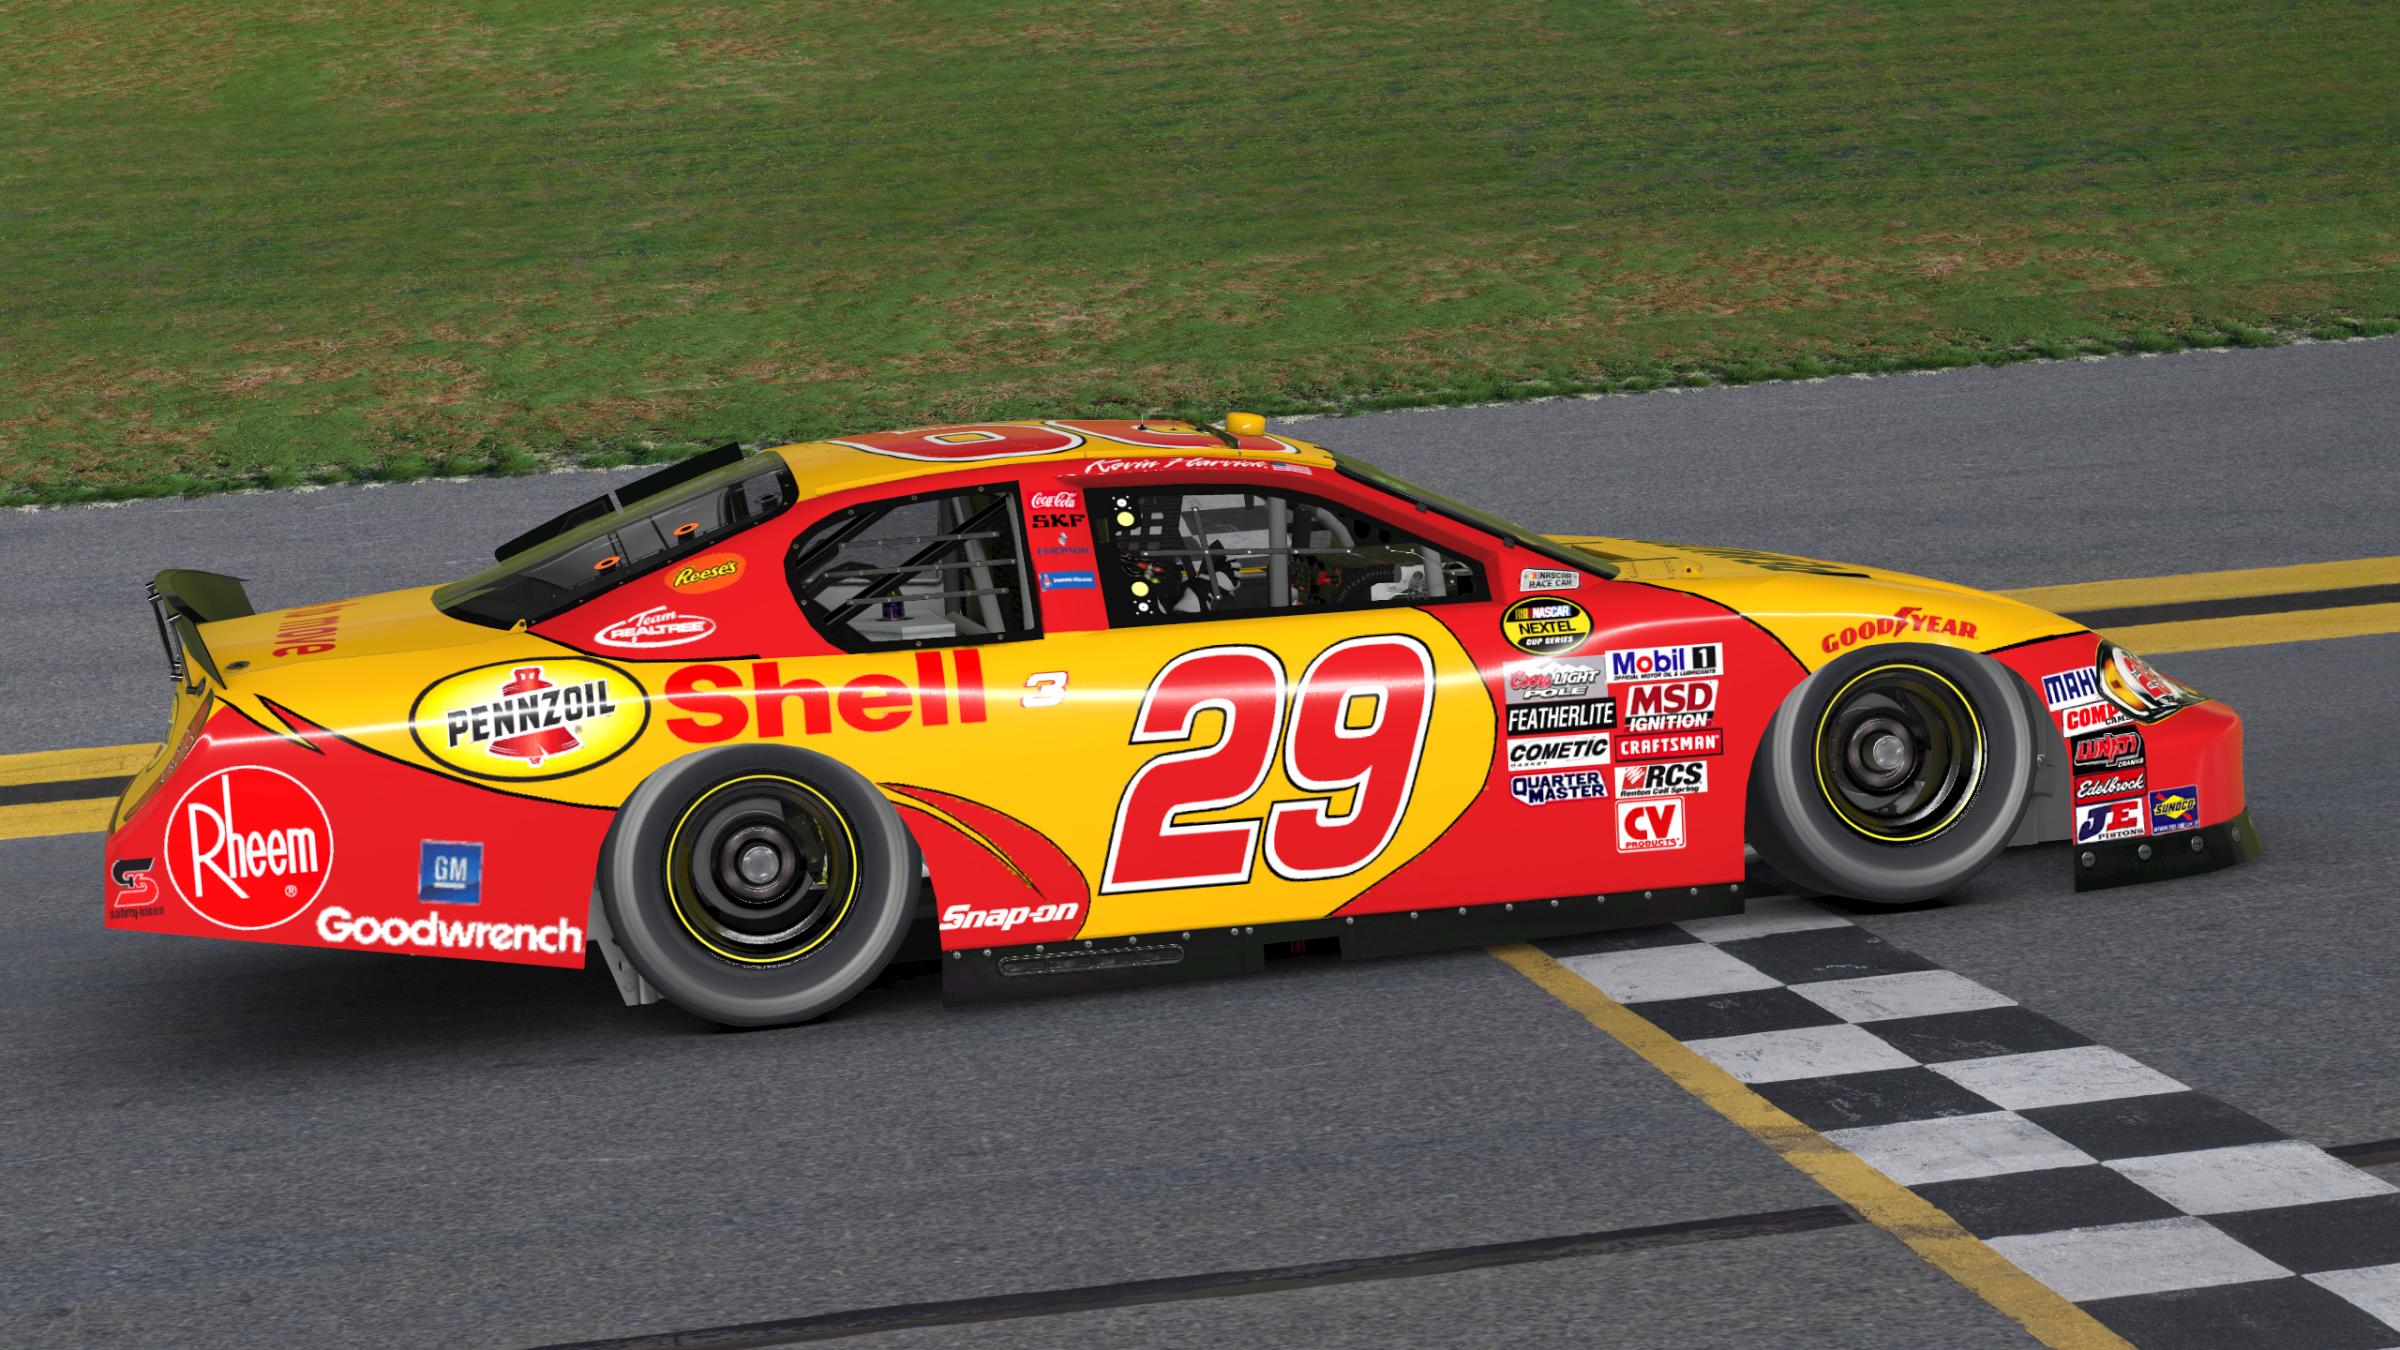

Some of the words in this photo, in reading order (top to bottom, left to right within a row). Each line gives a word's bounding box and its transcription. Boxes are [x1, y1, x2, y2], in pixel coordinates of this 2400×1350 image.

[1085, 459, 1160, 475] Kevin
[1031, 492, 1077, 508] Coca-Cola
[1032, 514, 1085, 528] SKF
[674, 561, 736, 587] Reese's
[1529, 580, 1552, 588] RACE
[627, 605, 677, 627] Team
[1532, 605, 1569, 618] NASCAR
[611, 621, 706, 639] REALTREE
[1519, 621, 1576, 634] NEXTEL
[1821, 606, 1978, 654] GOODYEAR
[1545, 636, 1573, 644] SERIES
[1612, 648, 1685, 675] Mobil
[1020, 671, 1068, 708] 3
[1510, 671, 1553, 689] Coors
[1553, 670, 1600, 685] LIGHT
[665, 648, 987, 744] Shell
[1523, 687, 1588, 699] POLE
[1630, 683, 1713, 715] MSD
[447, 680, 616, 748] PENNZOIL
[1508, 702, 1615, 732] FEATHERLITE
[1630, 713, 1708, 732] IGNITION
[1510, 737, 1608, 762] COMETIC
[1621, 735, 1716, 755] CRAFTSMAN
[2076, 734, 2138, 762] LUNATI
[1098, 633, 1435, 895] 29
[2118, 757, 2144, 768] CRANKS
[1512, 772, 1600, 796] QUARTER
[1645, 762, 1703, 788] RCS
[2077, 773, 2144, 798] Edelbrock
[1529, 784, 1605, 803] MASTER
[1671, 785, 1700, 793] Spring
[2155, 799, 2195, 814] SUNOCO
[1624, 804, 1676, 840] CV
[2079, 801, 2139, 841] JE
[187, 774, 319, 899] Rheem
[1625, 838, 1677, 848] PRODUCTS
[2098, 828, 2144, 840] PISTONS
[434, 855, 468, 881] GM
[939, 902, 1079, 931] Snap-on
[316, 906, 582, 953] Goodwrench
